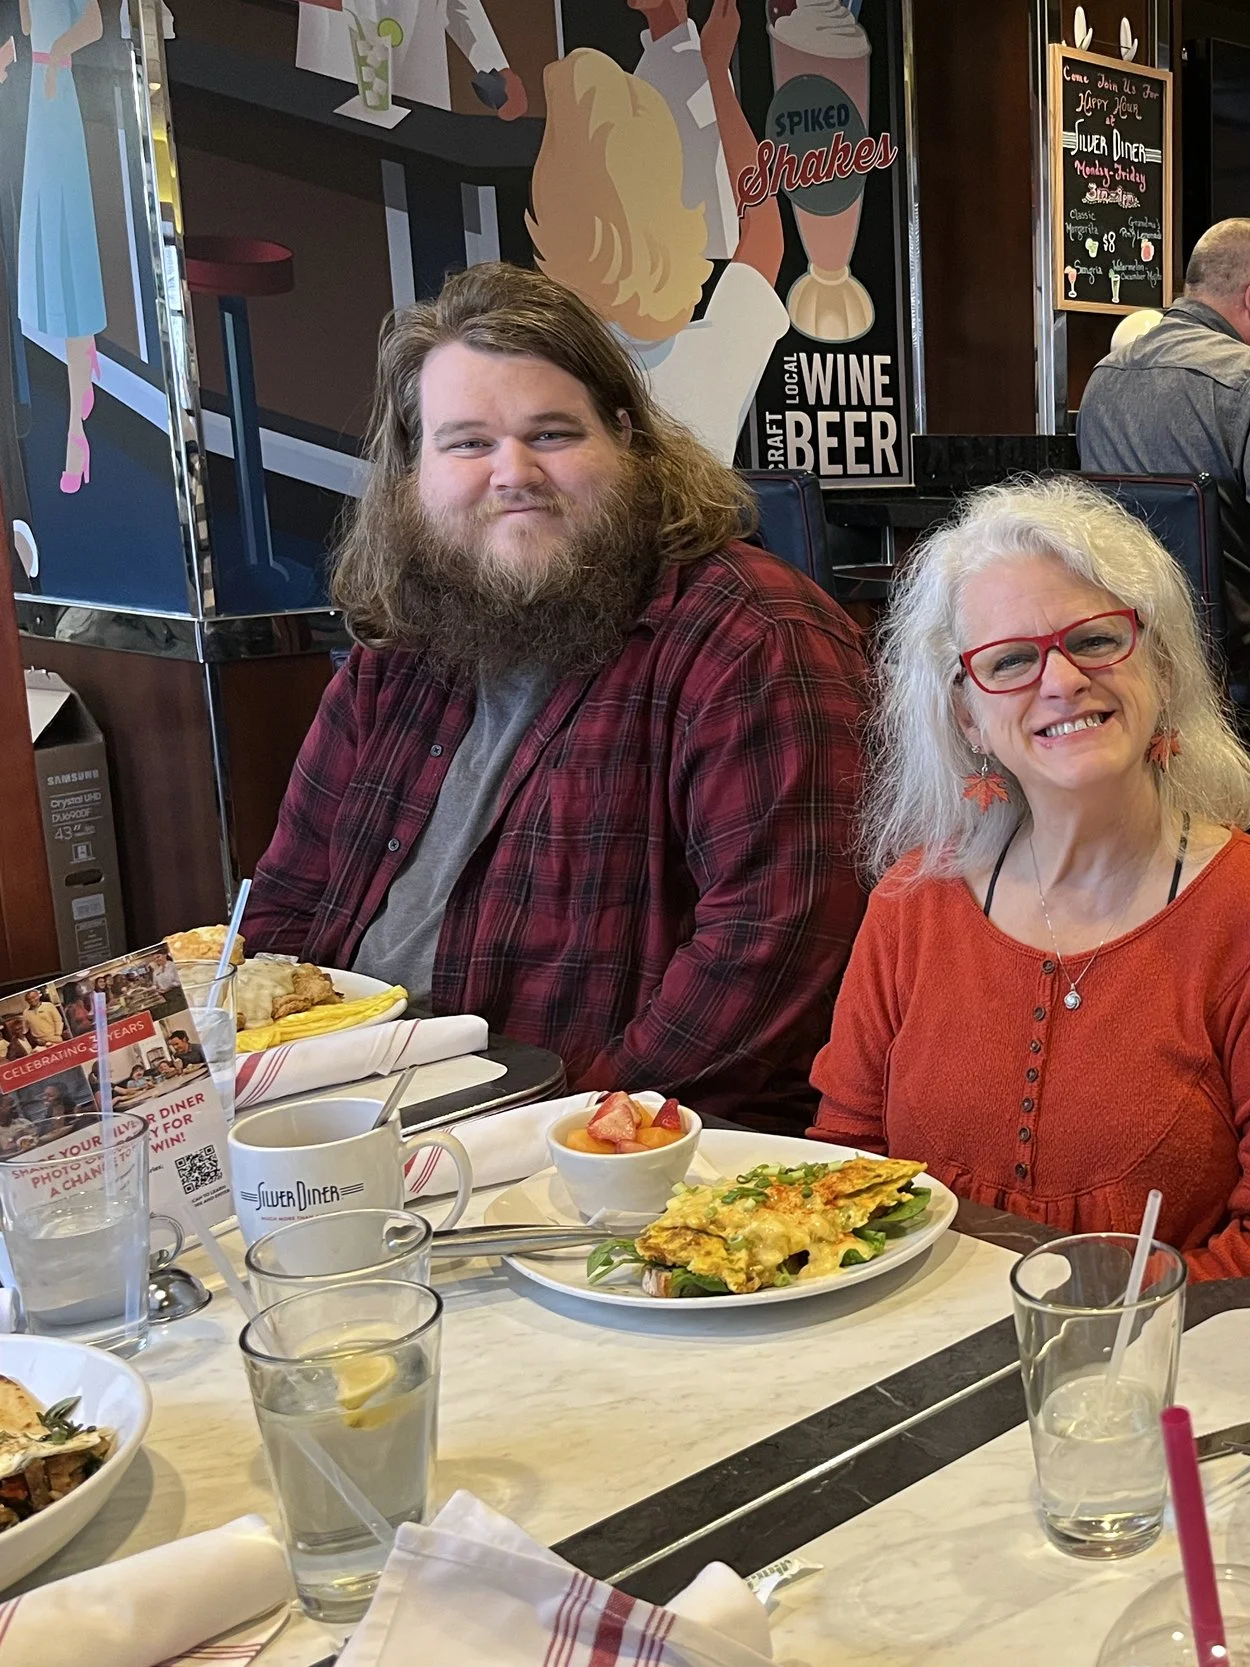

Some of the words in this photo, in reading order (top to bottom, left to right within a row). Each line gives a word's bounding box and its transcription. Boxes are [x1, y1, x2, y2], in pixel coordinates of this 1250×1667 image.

[1063, 65, 1090, 84] Come
[1097, 73, 1118, 93] Join
[1122, 78, 1137, 95] Us
[1142, 84, 1160, 99] For
[775, 103, 850, 137] SPIKED
[1070, 118, 1108, 156] SILVER
[736, 131, 899, 218] Shakes
[1102, 231, 1116, 253] $8
[783, 352, 799, 404] LOCAL
[799, 352, 894, 406] WINE
[785, 411, 899, 476] BEER
[47, 769, 99, 786] SAMSUNG
[2, 1042, 87, 1081] CELEBRATING
[108, 1020, 146, 1042] YEARS
[31, 1161, 81, 1189] PHOTO
[163, 1113, 194, 1134] FOR
[59, 1135, 102, 1159] YOUR
[159, 1092, 206, 1119] DINER
[50, 1187, 61, 1198] A
[150, 1131, 187, 1154] WIN!
[255, 1181, 296, 1211] SILVER
